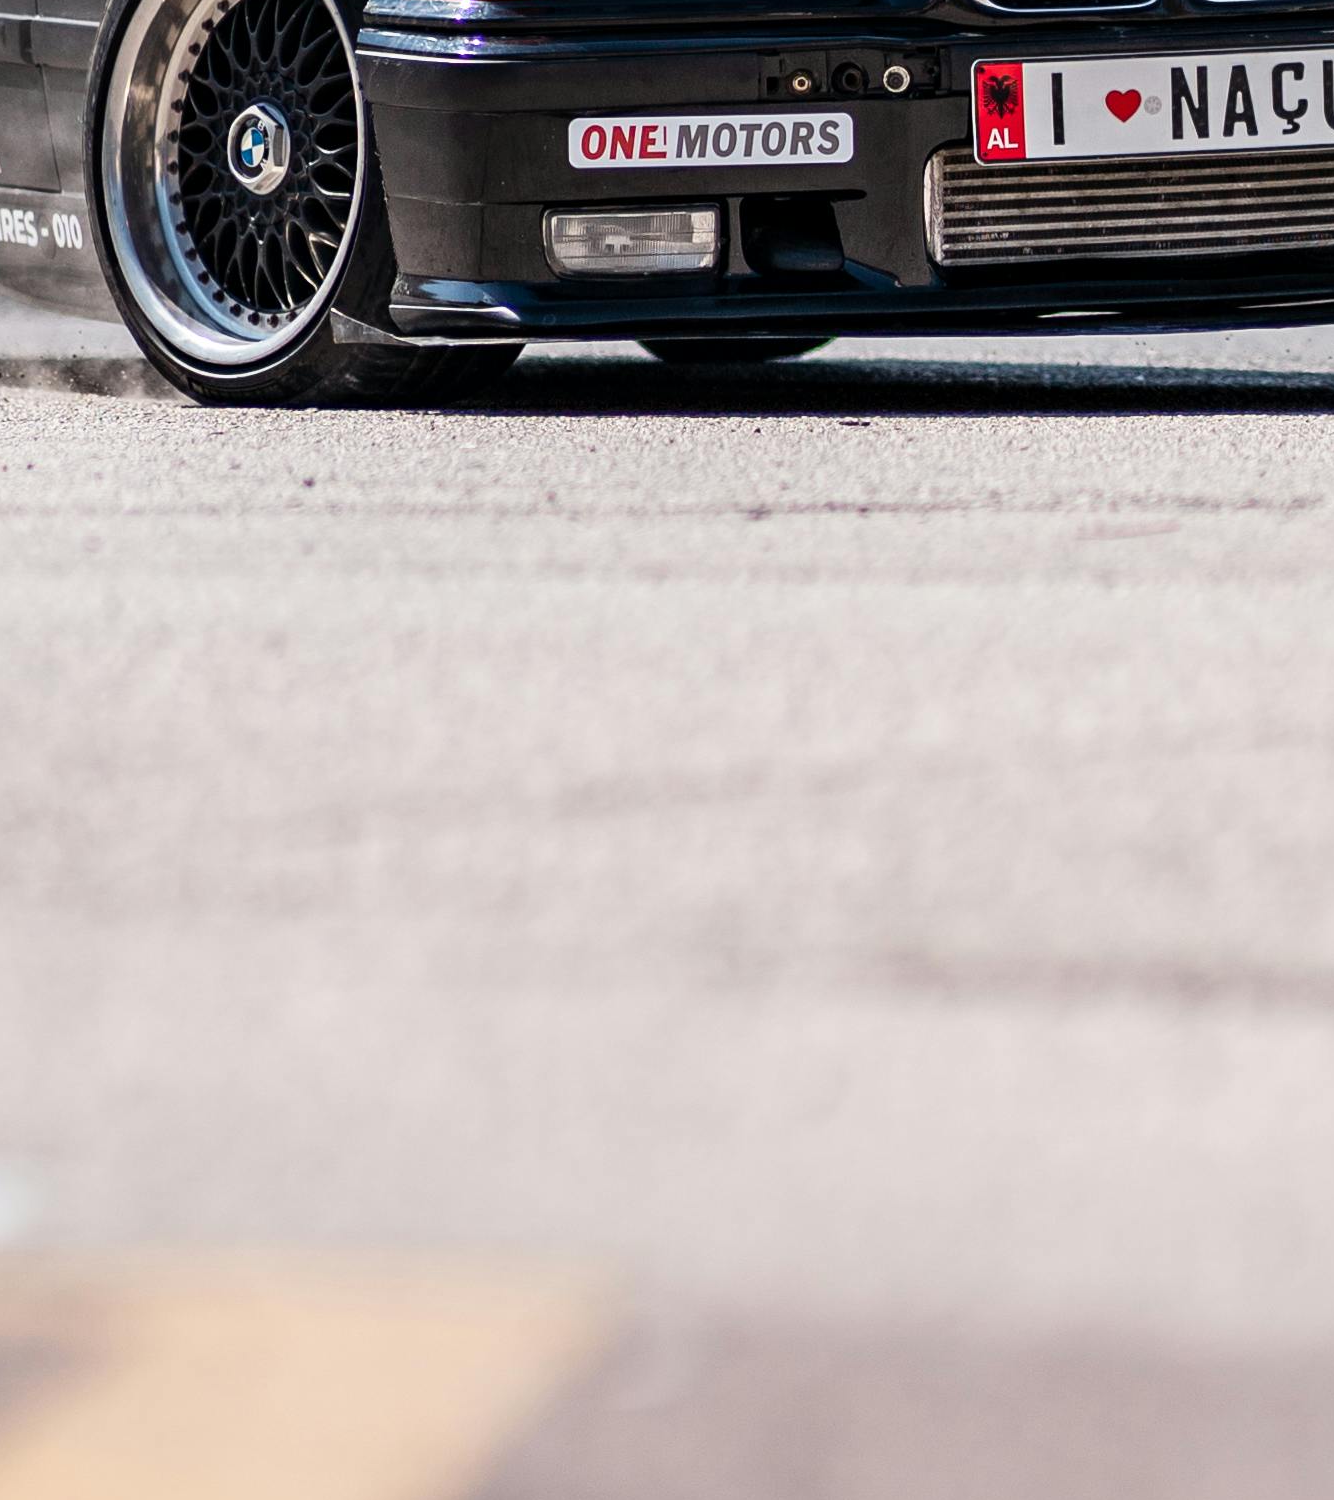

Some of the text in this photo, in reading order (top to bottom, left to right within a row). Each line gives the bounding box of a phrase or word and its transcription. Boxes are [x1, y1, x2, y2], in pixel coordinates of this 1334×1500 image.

[1050, 72, 1065, 146] I
[675, 119, 840, 159] MOTORS
[986, 127, 1019, 150] AL
[52, 213, 83, 250] 010
